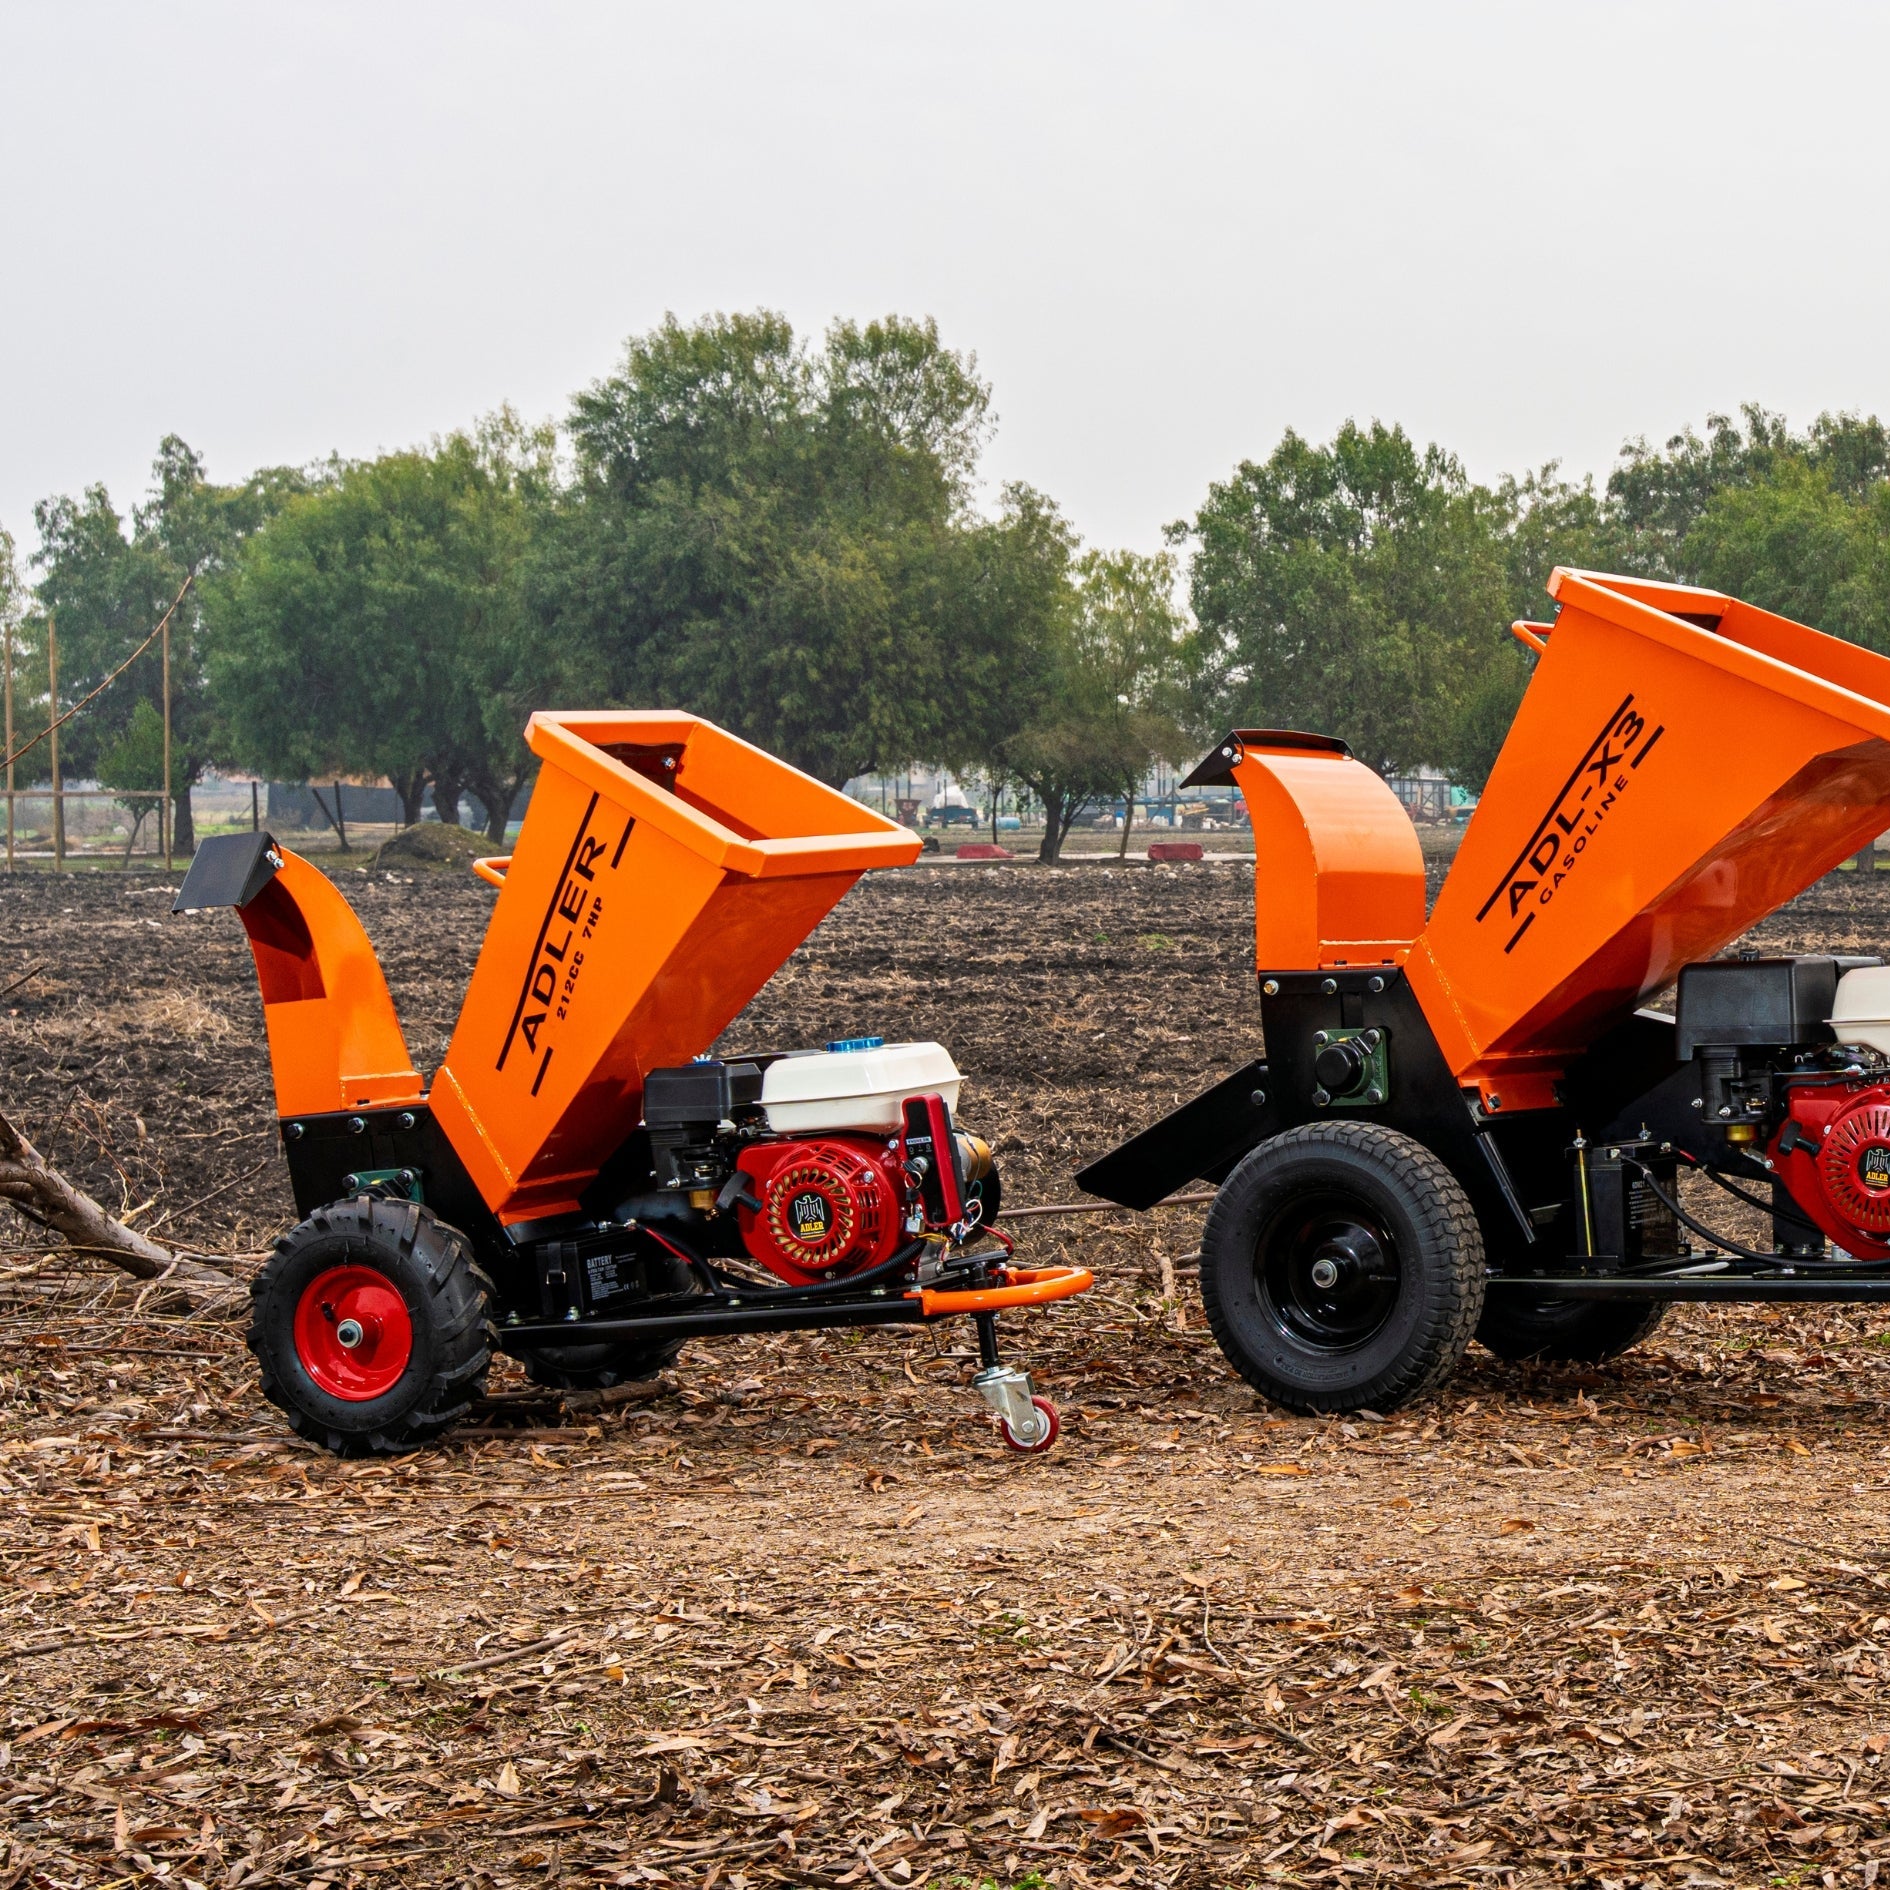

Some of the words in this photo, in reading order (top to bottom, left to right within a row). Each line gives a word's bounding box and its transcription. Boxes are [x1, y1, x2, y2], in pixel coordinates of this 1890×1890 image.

[1508, 710, 1645, 918] ADL-X3
[1539, 775, 1628, 905] GASOLINE
[521, 836, 607, 1054] ADLER
[556, 951, 584, 1020] 212CC
[582, 897, 603, 939] 7HP
[800, 1221, 825, 1233] ADLER
[1866, 1171, 1889, 1182] ADLER
[586, 1254, 613, 1269] BATTERY
